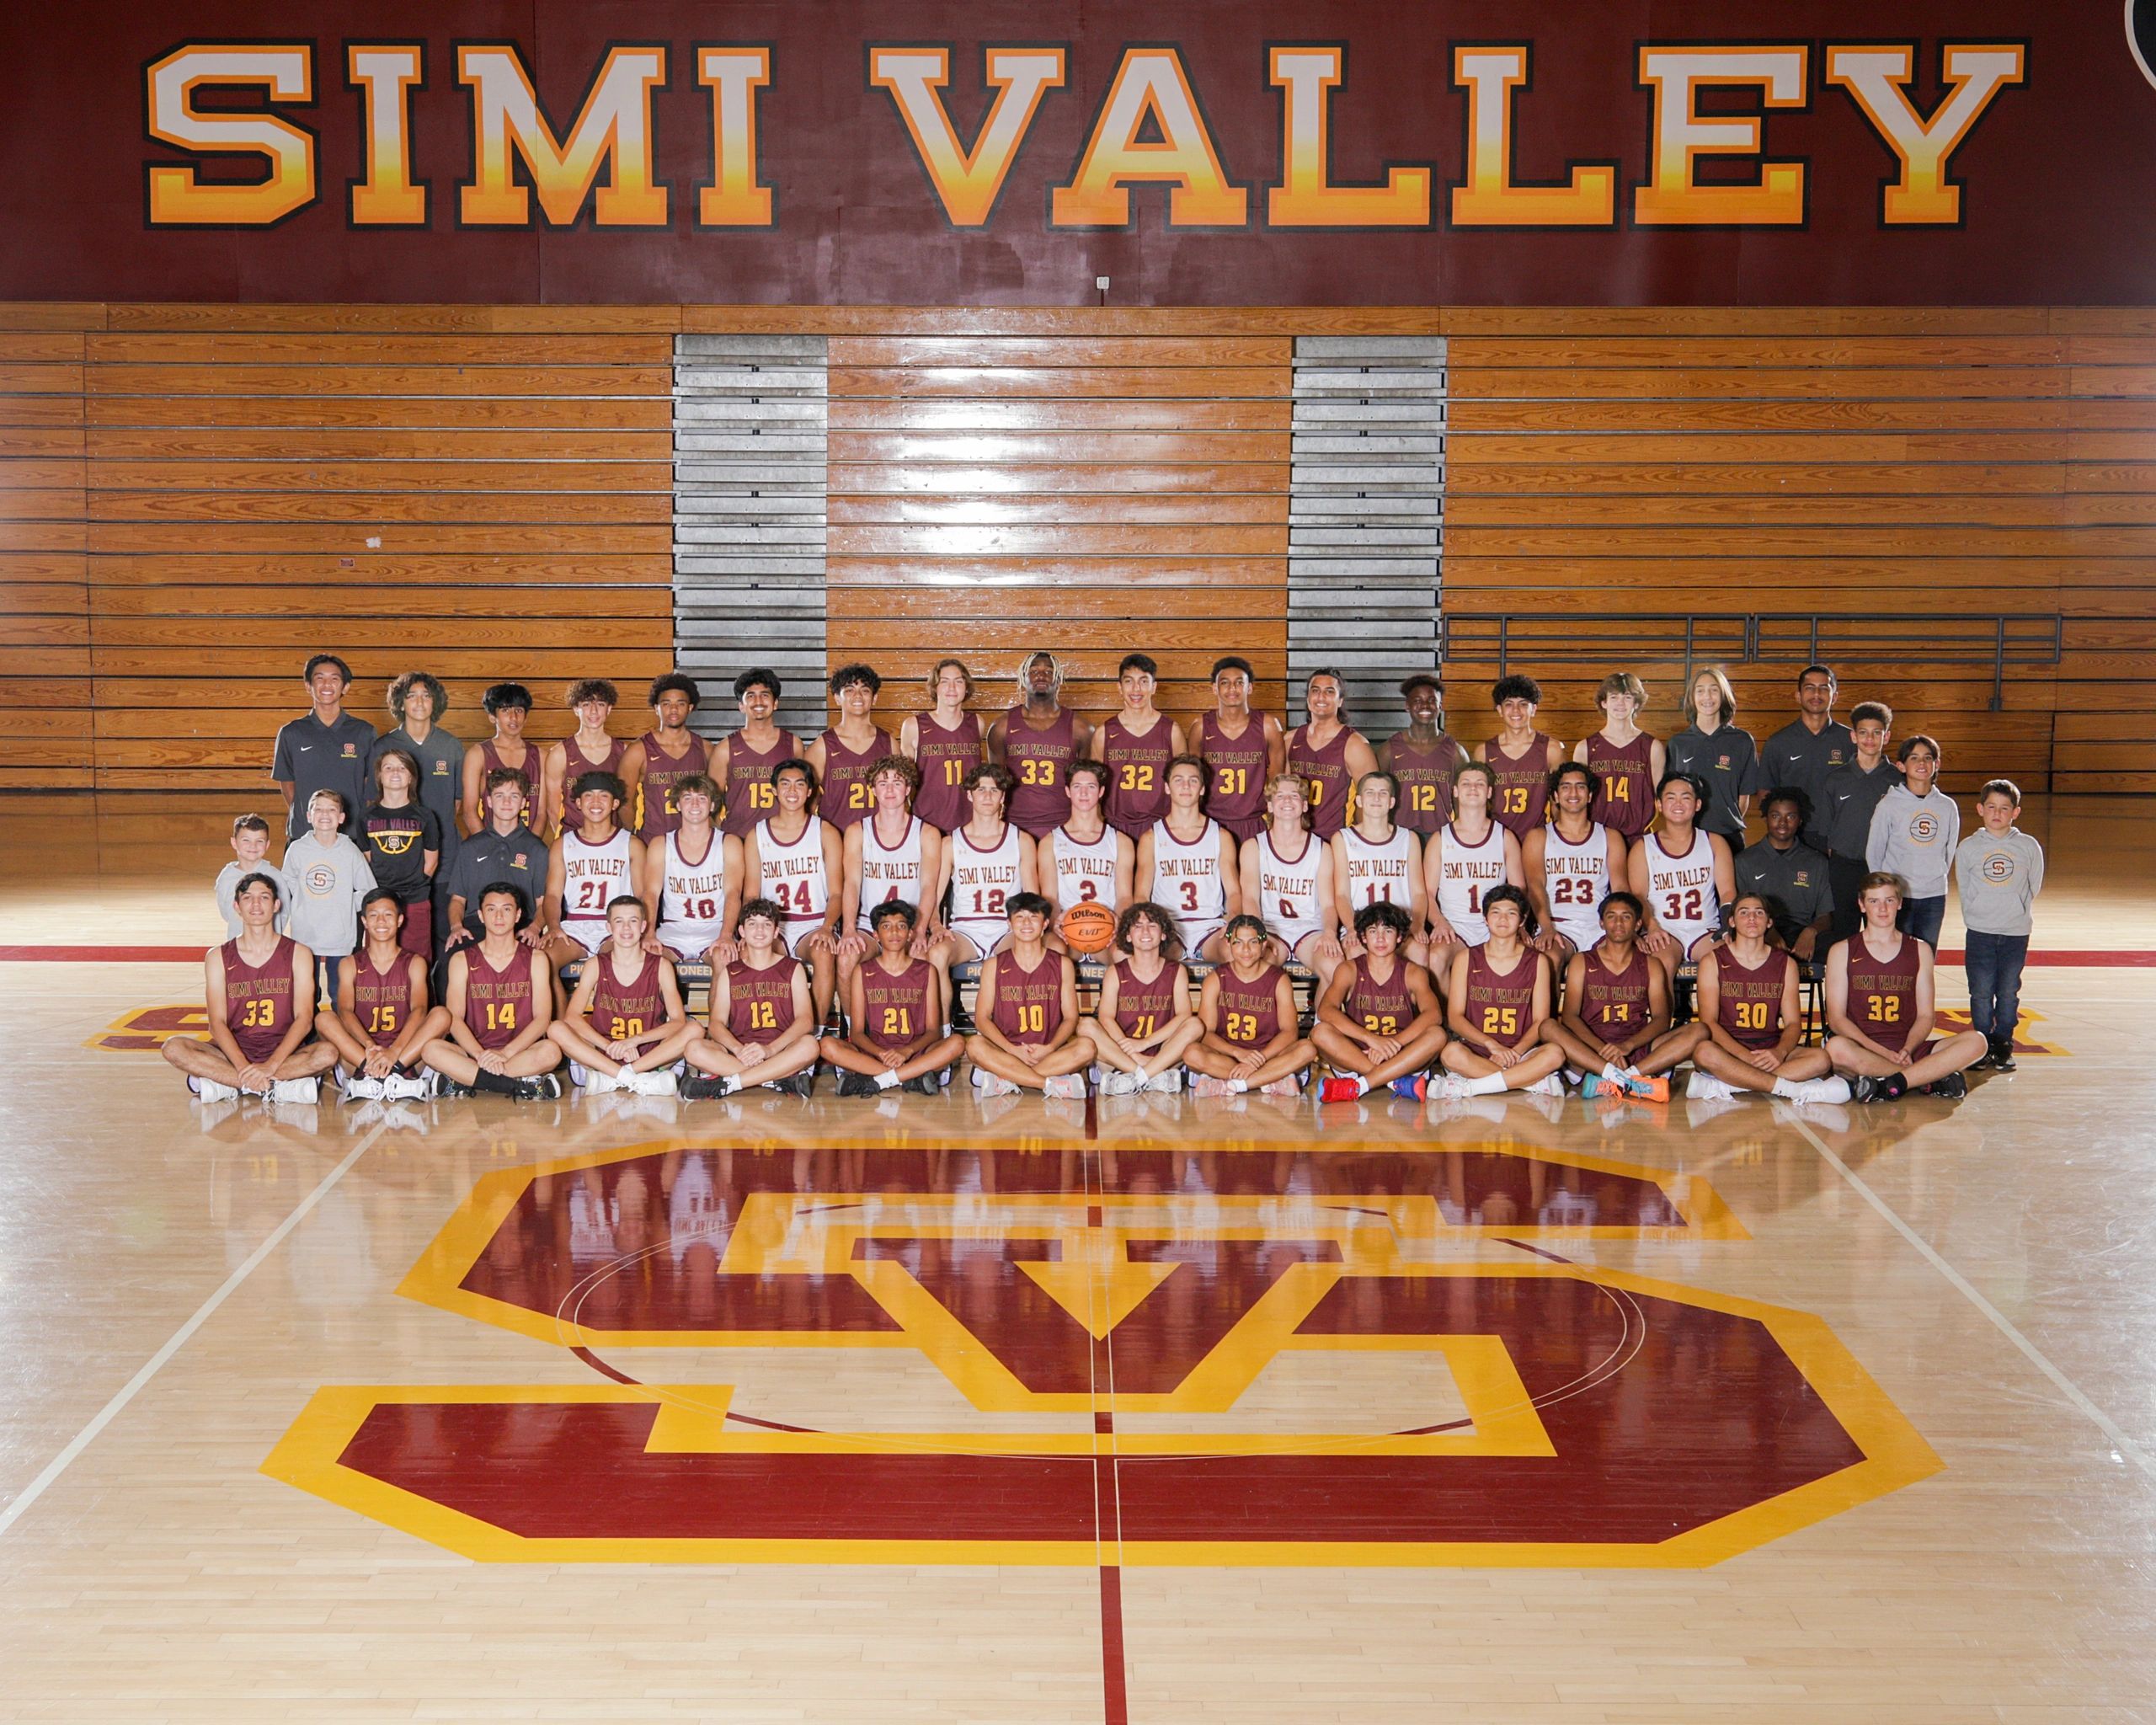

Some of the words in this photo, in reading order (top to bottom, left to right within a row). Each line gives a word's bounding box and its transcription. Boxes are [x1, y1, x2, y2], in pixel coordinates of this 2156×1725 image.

[145, 41, 775, 228] SIMI
[865, 41, 2028, 229] VALLEY
[921, 744, 943, 756] SIMI
[1031, 744, 1070, 758] VALLEY
[1129, 748, 1169, 761] VALLEY
[943, 760, 963, 786] 11
[1021, 760, 1054, 785] 33
[1119, 765, 1153, 791] 32
[1219, 768, 1246, 794] 31
[749, 782, 774, 809] 15
[849, 782, 875, 809] 21
[1411, 785, 1436, 811] 12
[1502, 788, 1528, 814] 13
[1605, 777, 1629, 803] 14
[368, 819, 387, 831] SIMI
[390, 818, 421, 831] VALLEY
[568, 859, 585, 879] SIMI
[589, 858, 626, 877] VALLEY
[762, 859, 781, 879] SIMI
[784, 857, 819, 875] VALLEY
[864, 861, 881, 879] SIMI
[884, 862, 919, 879] VALLEY
[958, 868, 978, 884] SIMI
[980, 866, 1016, 884] VALLEY
[1058, 858, 1076, 875] SIMI
[1080, 857, 1115, 877] VALLEY
[1160, 859, 1178, 877] SIMI
[1181, 857, 1215, 876] VALLEY
[1348, 860, 1369, 878] SIMI
[1372, 859, 1406, 877] VALLEY
[1444, 862, 1464, 879] SIMI
[1466, 862, 1502, 879] VALLEY
[1545, 857, 1565, 875] SIMI
[1569, 857, 1603, 874] VALLEY
[1653, 873, 1673, 890] SIMI
[1677, 866, 1710, 887] VALLEY
[578, 881, 607, 910] 21
[669, 876, 686, 894] SIMI
[688, 873, 723, 895] VALLEY
[776, 880, 813, 913] 34
[1079, 880, 1097, 902] 2
[1180, 882, 1198, 911] 3
[1279, 877, 1313, 896] VALLEY
[1366, 882, 1390, 904] 11
[1555, 879, 1593, 905] 23
[683, 898, 716, 919] 10
[973, 889, 1006, 914] 12
[1662, 889, 1702, 920] 32
[1071, 910, 1105, 920] Wilson
[243, 999, 275, 1027] 33
[369, 1006, 396, 1033] 15
[486, 1003, 515, 1030] 14
[750, 1001, 776, 1028] 12
[884, 1007, 910, 1034] 21
[1018, 1005, 1043, 1033] 10
[1483, 1007, 1517, 1035] 25
[1736, 1002, 1768, 1029] 30
[1868, 996, 1900, 1022] 32
[611, 1017, 643, 1040] 20
[1133, 1015, 1155, 1039] 11
[1226, 1012, 1257, 1041] 23
